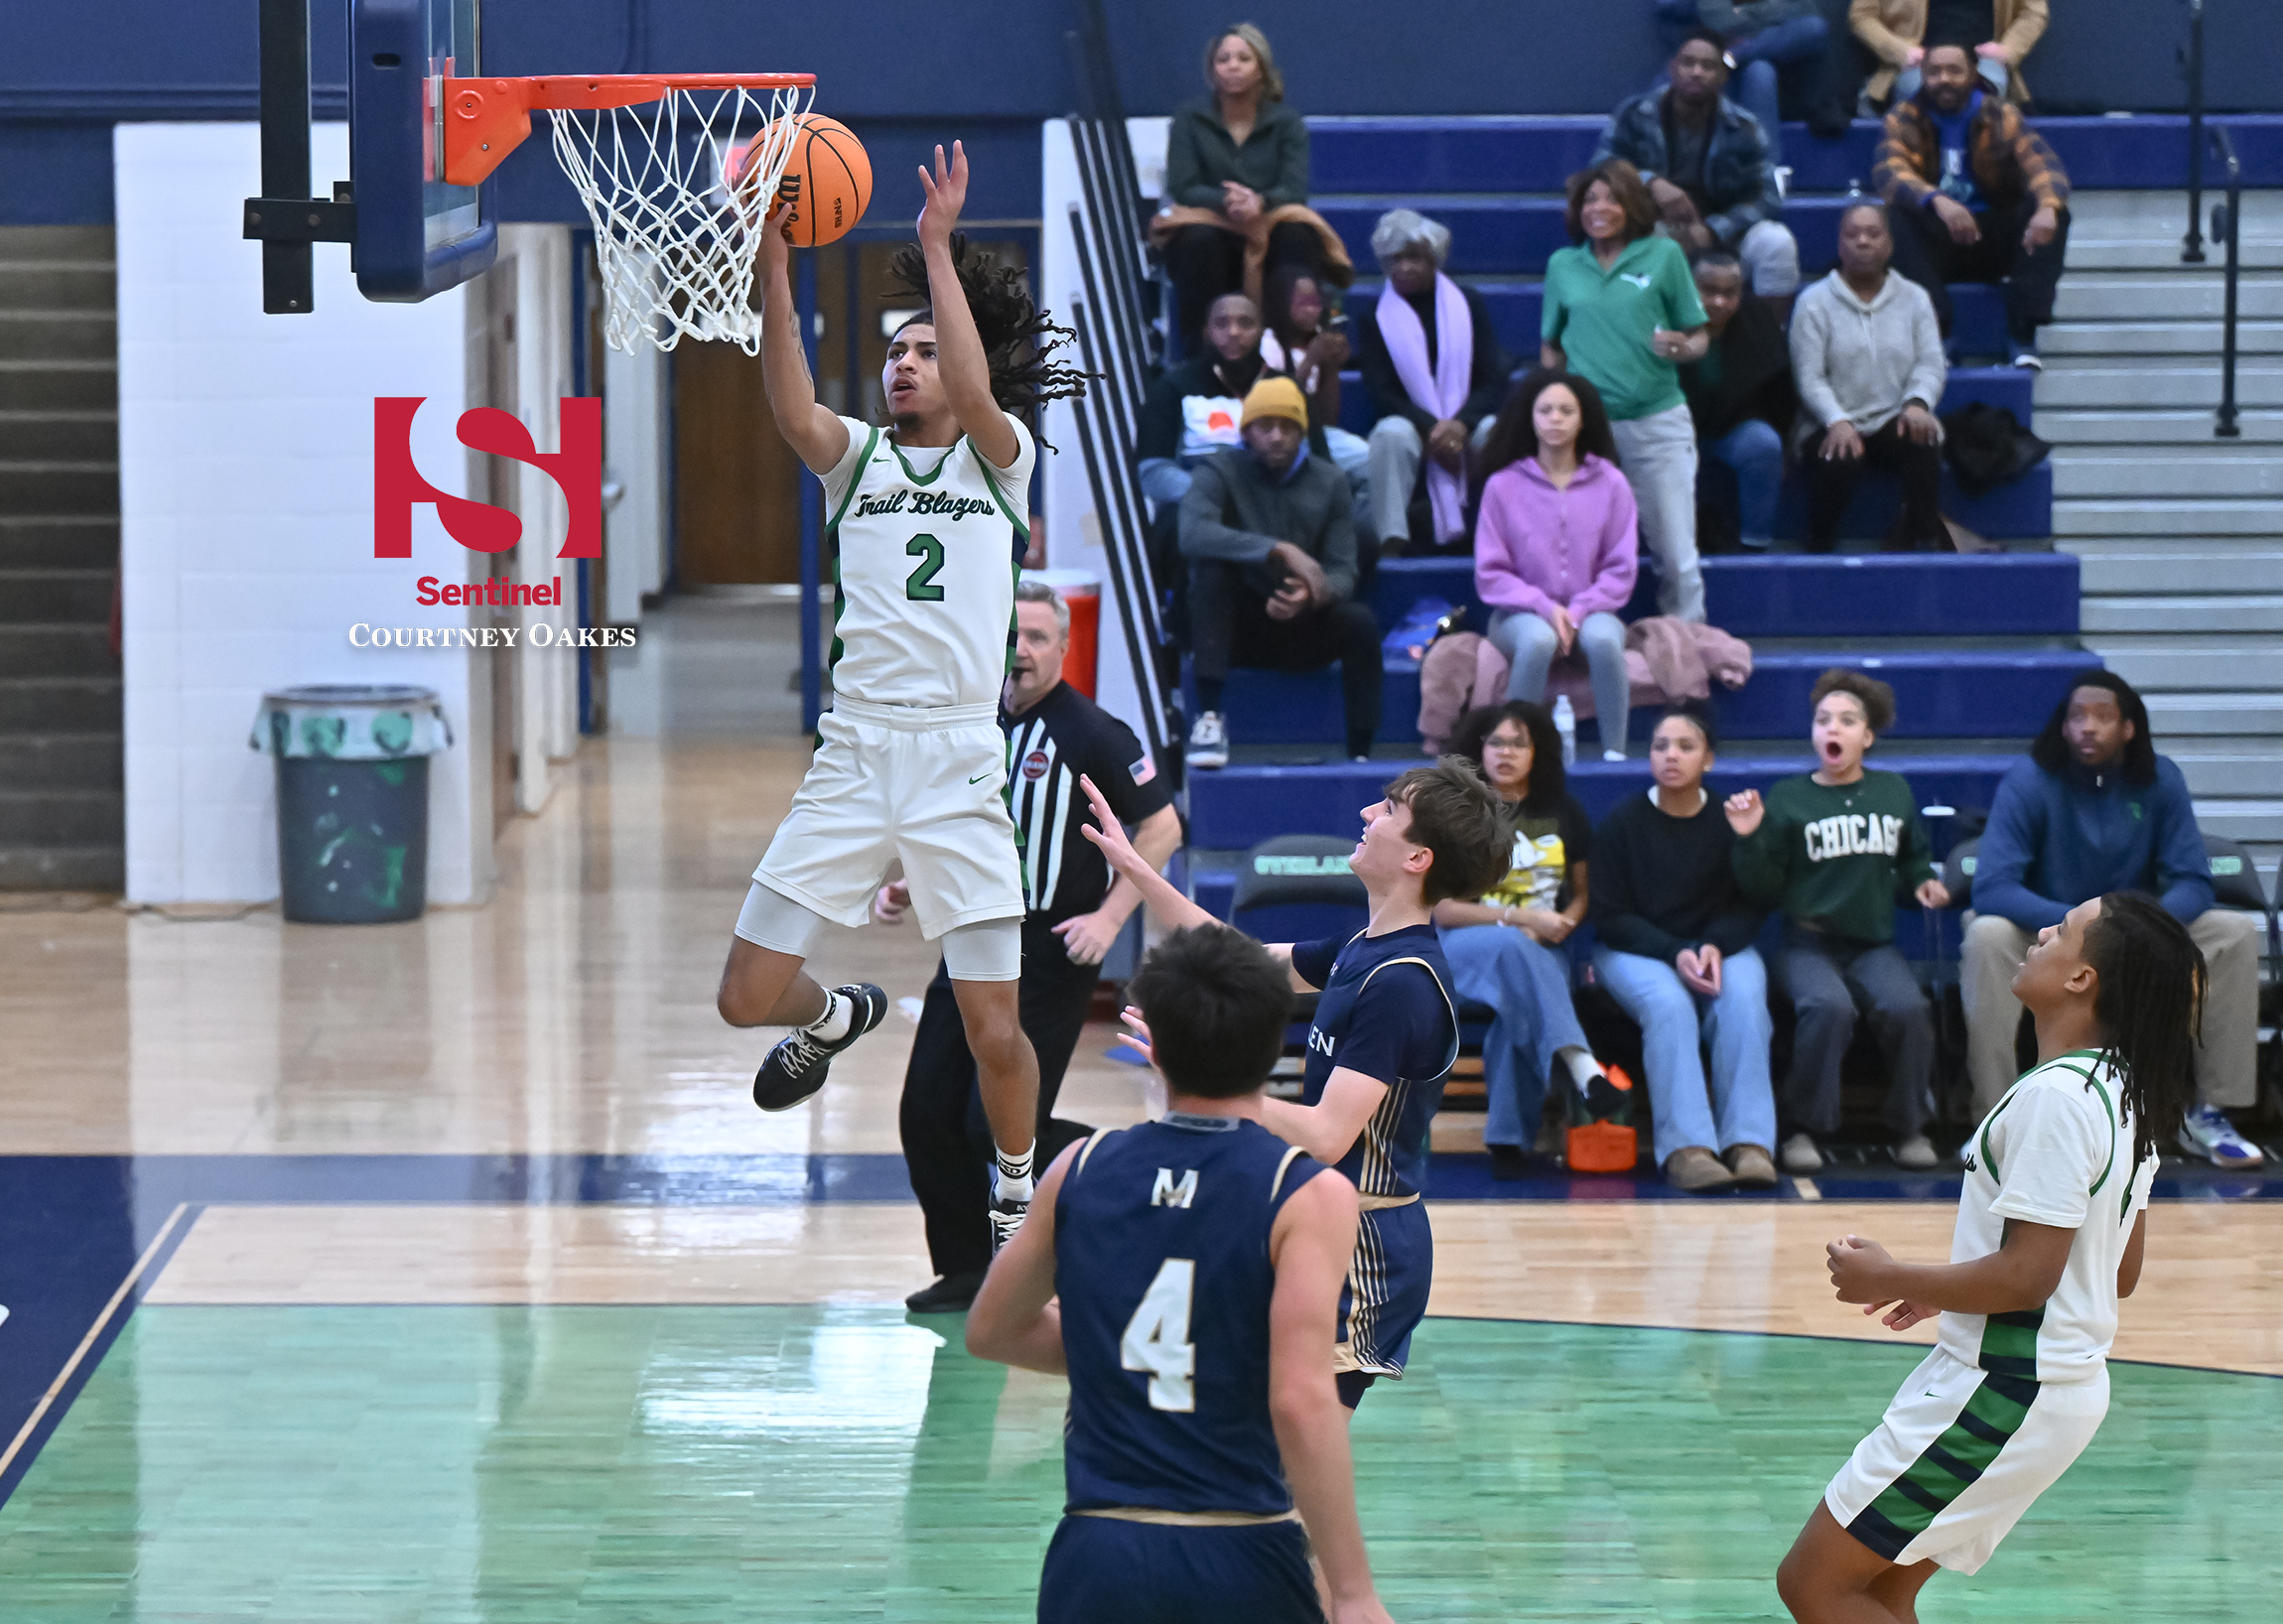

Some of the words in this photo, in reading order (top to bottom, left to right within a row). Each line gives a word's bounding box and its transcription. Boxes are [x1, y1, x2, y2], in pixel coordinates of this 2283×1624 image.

[854, 488, 908, 518] Trail
[907, 489, 996, 522] Blazers
[905, 533, 945, 602] 2
[1149, 1166, 1200, 1209] M
[1119, 1256, 1197, 1414] 4
